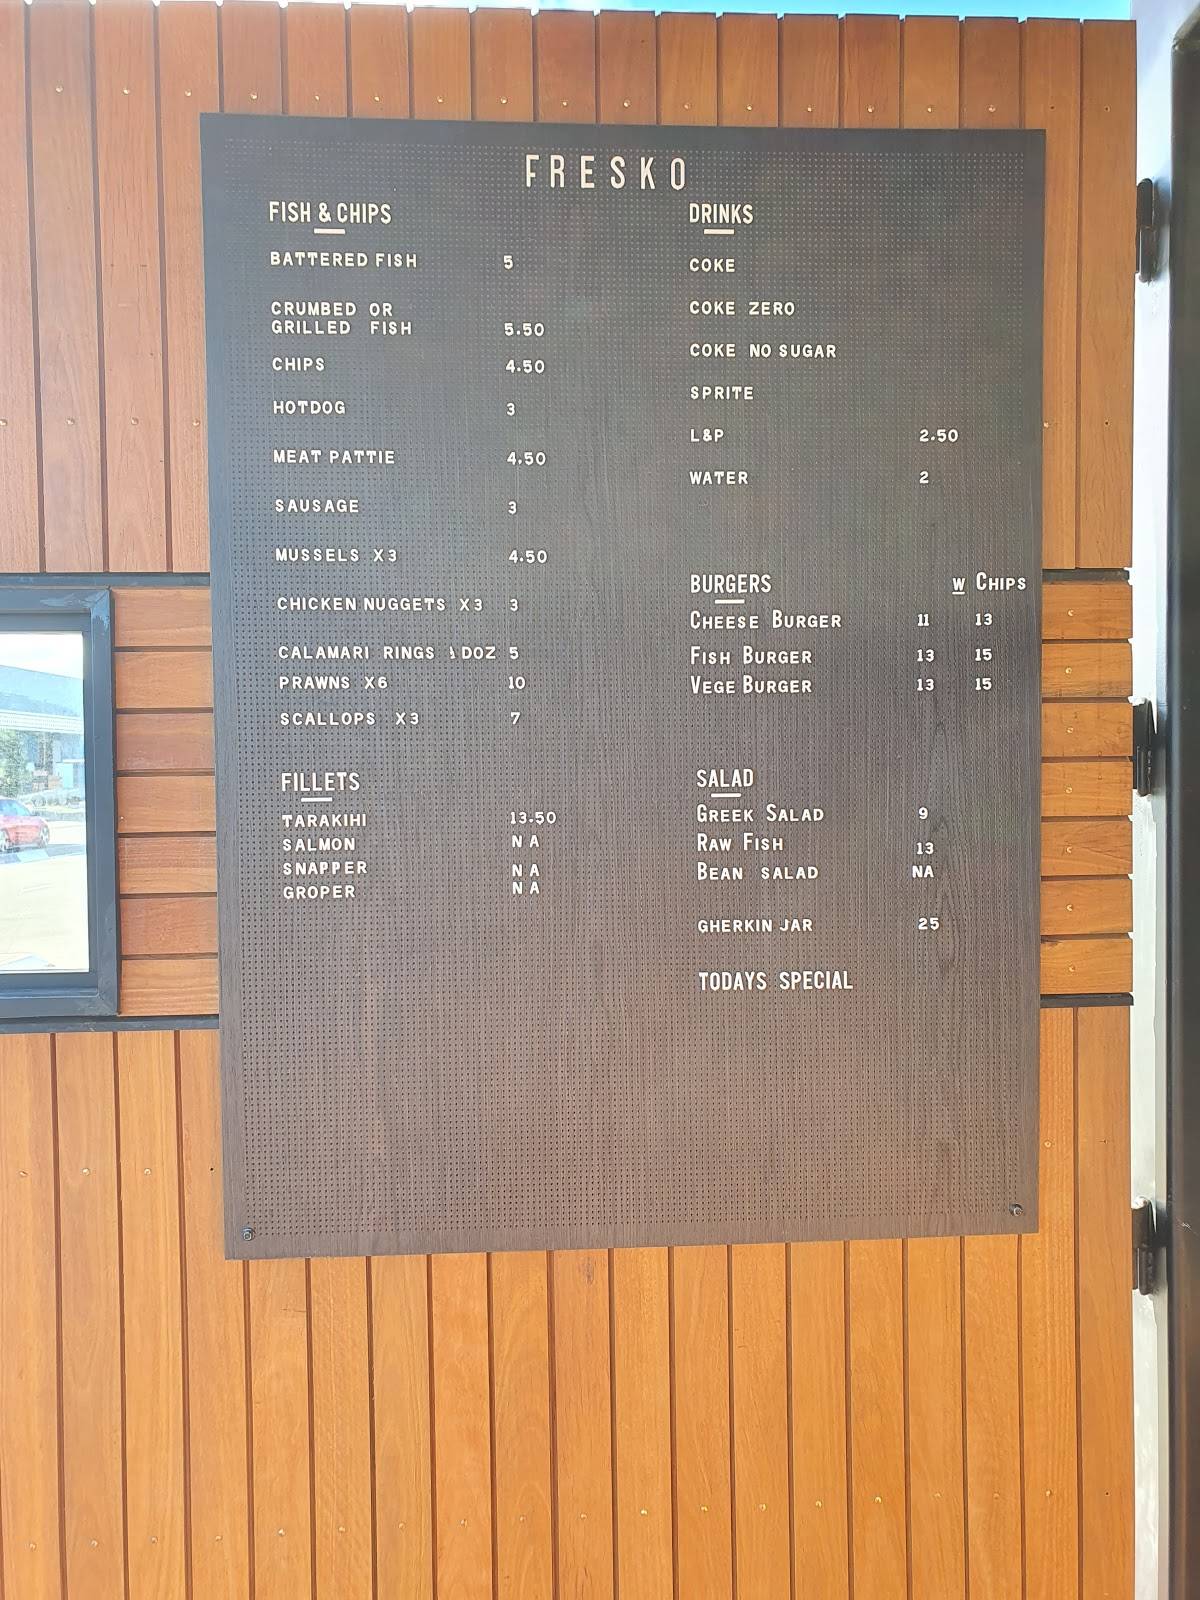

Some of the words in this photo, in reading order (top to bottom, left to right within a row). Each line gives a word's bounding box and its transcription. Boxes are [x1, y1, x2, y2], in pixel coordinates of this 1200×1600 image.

[525, 154, 687, 191] FRESKO
[269, 200, 311, 223] FISH
[318, 203, 332, 224] &
[336, 203, 392, 225] CHIPS
[689, 202, 754, 225] DRINKS
[270, 251, 368, 267] BATTERED
[375, 252, 417, 268] FISH
[503, 254, 514, 270] 5
[689, 257, 736, 273] COKE
[271, 301, 357, 317] CRUMBED
[369, 302, 393, 317] OR
[689, 300, 736, 316] COKE
[748, 301, 795, 317] ZERO
[271, 319, 351, 335] GRILLED
[370, 320, 412, 336] FISH
[504, 322, 545, 337] 5.50
[689, 343, 736, 358] COKE
[749, 343, 772, 358] NO
[778, 343, 837, 359] SUGAR
[272, 357, 325, 372] CHIPS
[505, 359, 545, 374] 4.50
[690, 385, 754, 400] SPRITE
[273, 400, 346, 415] HOTDOG
[506, 402, 516, 417] 3
[919, 428, 959, 443] 2.50
[273, 449, 322, 464] MEAT
[329, 450, 395, 465] PATTIE
[689, 471, 748, 485] WATER
[919, 470, 929, 484] 2
[275, 498, 359, 513] SAUSAGE
[507, 500, 518, 515] 3
[275, 547, 359, 562] MUSSELS
[508, 549, 548, 564] 4.50
[690, 573, 772, 594] BURGERS
[277, 596, 357, 611] CHICKEN
[363, 597, 446, 612] NUGGETS
[510, 598, 519, 612] 3
[917, 613, 930, 627] 11
[975, 612, 993, 627] 13
[278, 645, 369, 660] CALAMARI
[383, 645, 435, 660] RINGS
[461, 645, 496, 660] DOZ
[509, 645, 519, 660] 5
[916, 648, 935, 663] 13
[974, 648, 993, 662] 15
[279, 675, 350, 690] PRAWNS
[508, 676, 526, 690] 10
[916, 678, 935, 692] 13
[975, 677, 992, 691] 15
[280, 711, 375, 726] SCALLOPS
[510, 711, 521, 725] 7
[281, 771, 360, 792] FILLETS
[696, 768, 754, 788] SALAD
[281, 812, 366, 828] TARAKIHI
[510, 811, 557, 826] 13.50
[918, 806, 929, 820] 9
[282, 836, 355, 852] SALMON
[916, 841, 934, 855] 13
[283, 859, 367, 876] SNAPPER
[912, 865, 935, 879] NA
[283, 883, 355, 900] GROPER
[697, 919, 773, 934] GHERKIN
[779, 918, 813, 933] JAR
[918, 917, 940, 931] 25
[698, 971, 767, 992] TODAYS
[779, 970, 854, 990] SPECIAL
